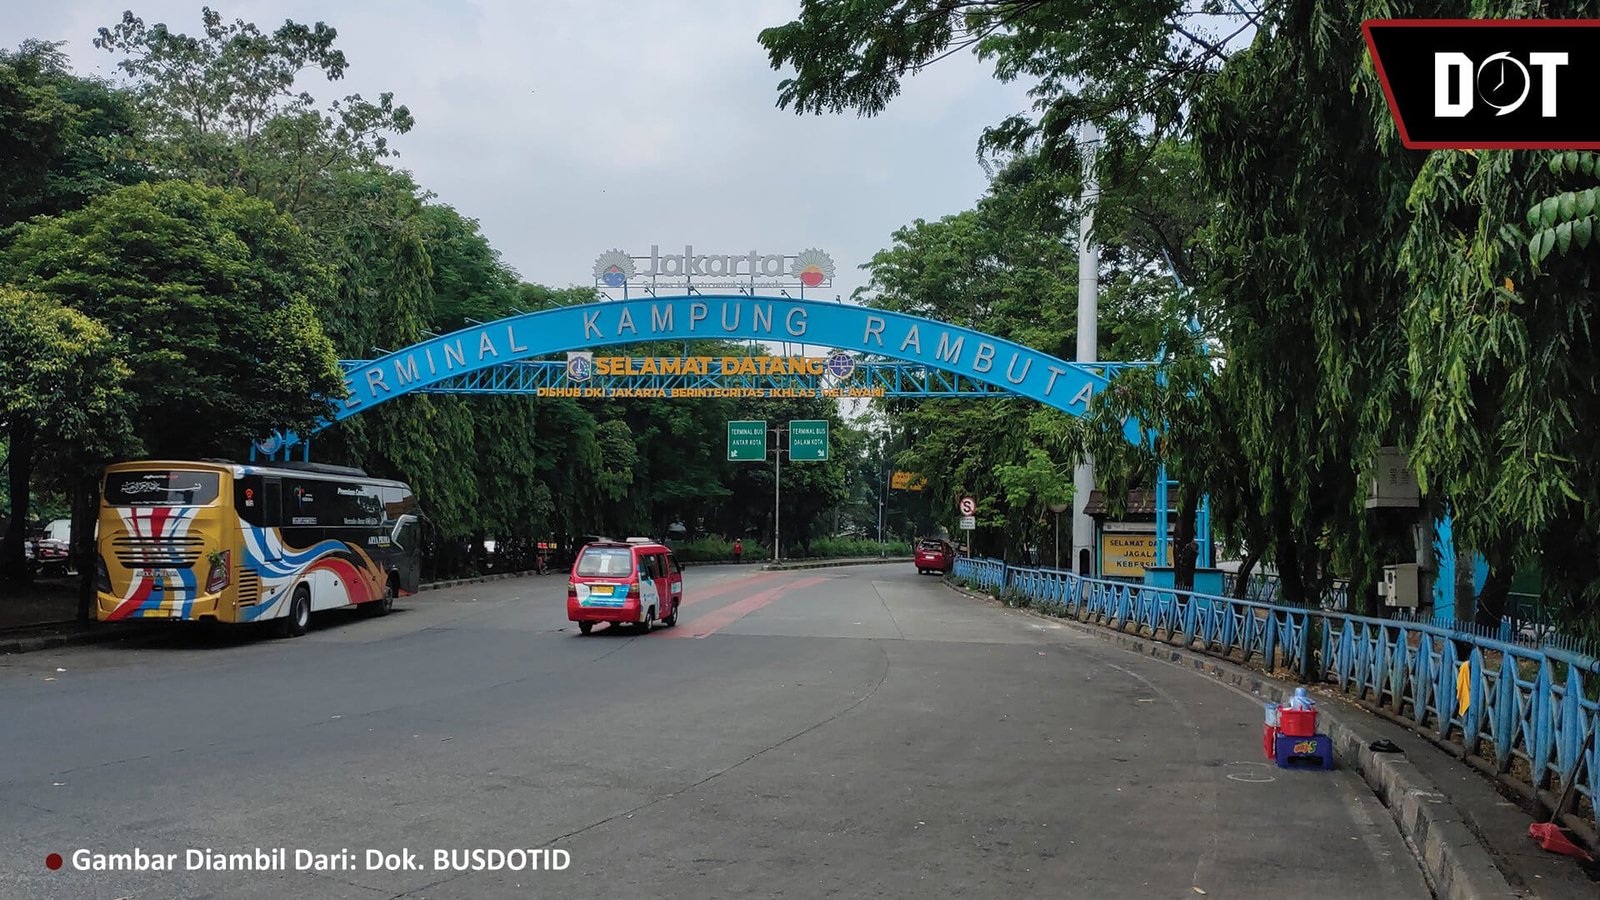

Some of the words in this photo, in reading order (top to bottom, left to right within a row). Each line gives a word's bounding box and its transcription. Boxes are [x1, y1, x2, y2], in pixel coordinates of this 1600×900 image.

[643, 245, 785, 277] Jakarta
[341, 325, 528, 408] ERMINAL
[583, 303, 808, 340] KAMPUNG
[863, 316, 1095, 412] RAMBUTA
[595, 356, 713, 376] SELAMAT
[721, 356, 825, 376] DATANG
[537, 387, 582, 398] DISHUB
[585, 387, 606, 398] DKI
[609, 387, 667, 398] JAKARTA
[671, 387, 765, 398] BERINTEGRITAS
[769, 387, 816, 398] IKHLAS
[822, 387, 886, 398] MELAYANI
[1116, 560, 1173, 568] KEBERSIN
